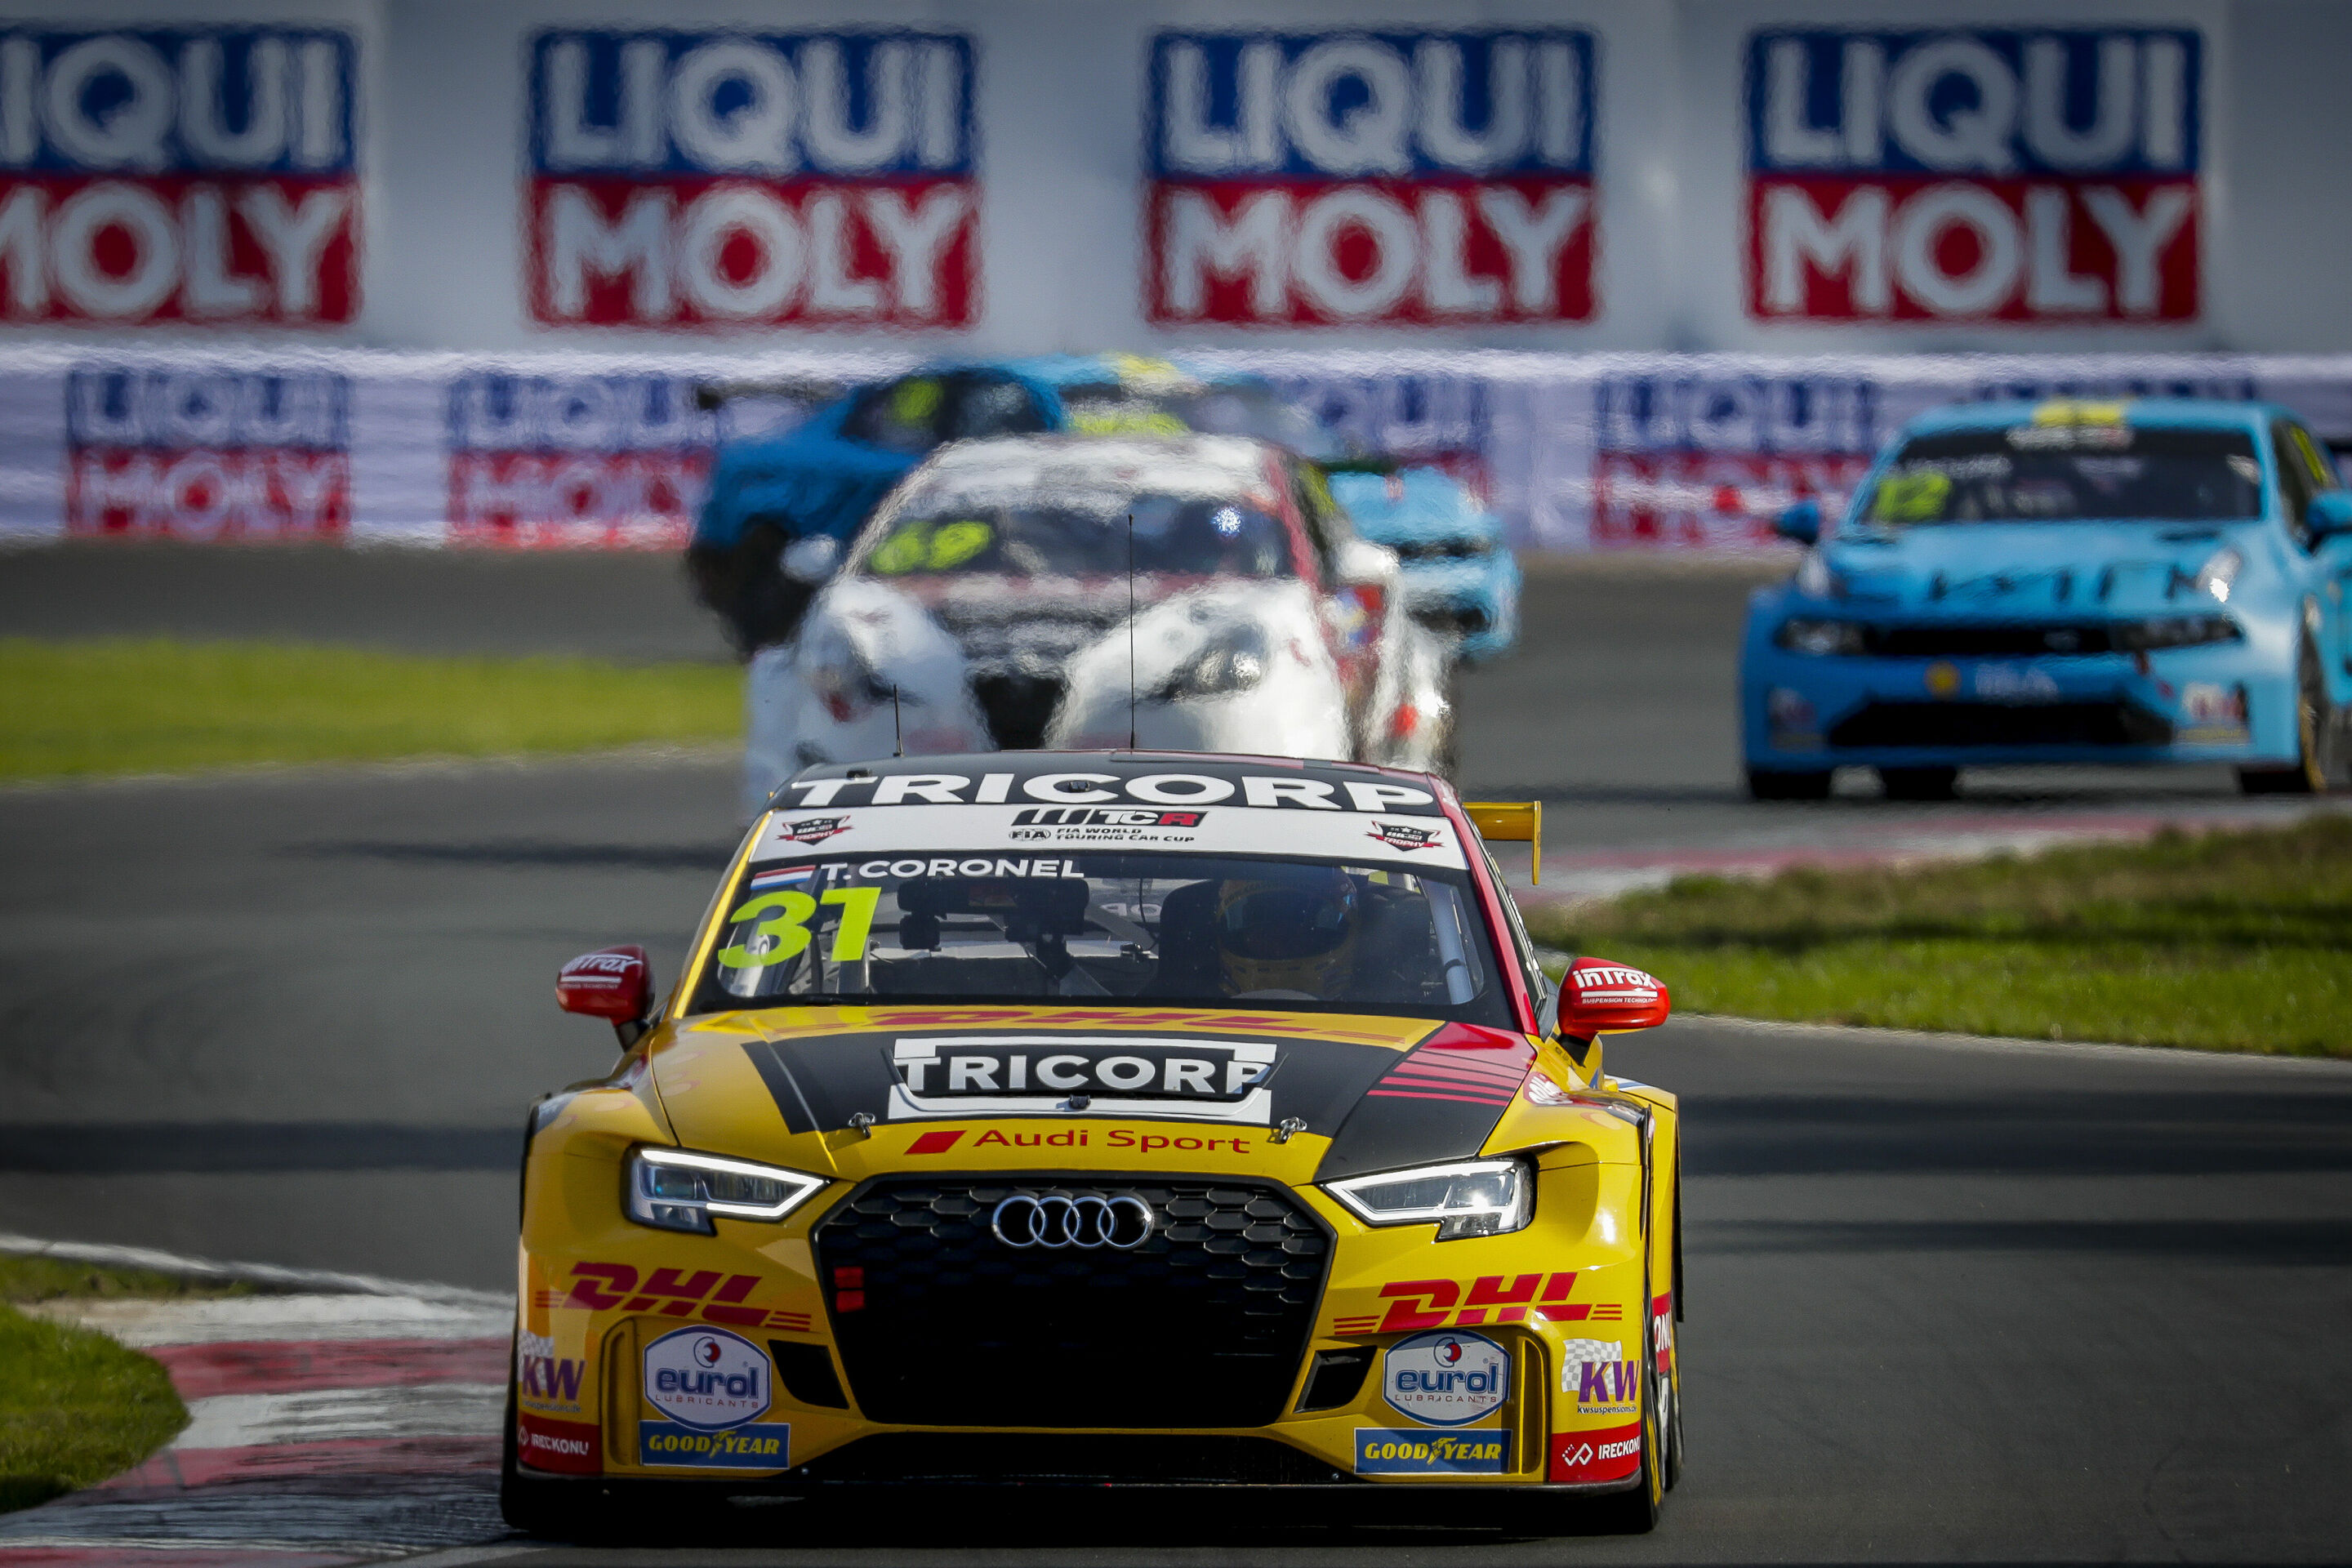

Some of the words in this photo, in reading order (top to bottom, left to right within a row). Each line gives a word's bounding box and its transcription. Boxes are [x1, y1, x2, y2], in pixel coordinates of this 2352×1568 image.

[546, 38, 956, 173] LIQUI
[1165, 38, 1578, 173] LIQUI
[1764, 38, 2186, 175] LIQUI
[550, 185, 969, 314] MOLY
[1165, 185, 1588, 314] MOLY
[1761, 185, 2195, 314] MOLY
[80, 451, 341, 539] MOLY
[791, 773, 1434, 813] TRICORP
[821, 862, 850, 881] T.
[859, 858, 1085, 879] CORONEL
[717, 886, 882, 969] 31
[893, 1054, 1271, 1094] TRICORP
[973, 1129, 1089, 1147] Audi
[1107, 1129, 1251, 1154] Sport
[563, 1261, 772, 1325] DHL
[1376, 1272, 1592, 1332] DHL
[522, 1354, 586, 1401] KW
[655, 1393, 760, 1409] LUBRICANTS
[656, 1367, 760, 1399] eurol
[1394, 1394, 1498, 1403] LUBRICANTS
[1395, 1363, 1499, 1394] eurol
[1578, 1359, 1641, 1402] KW
